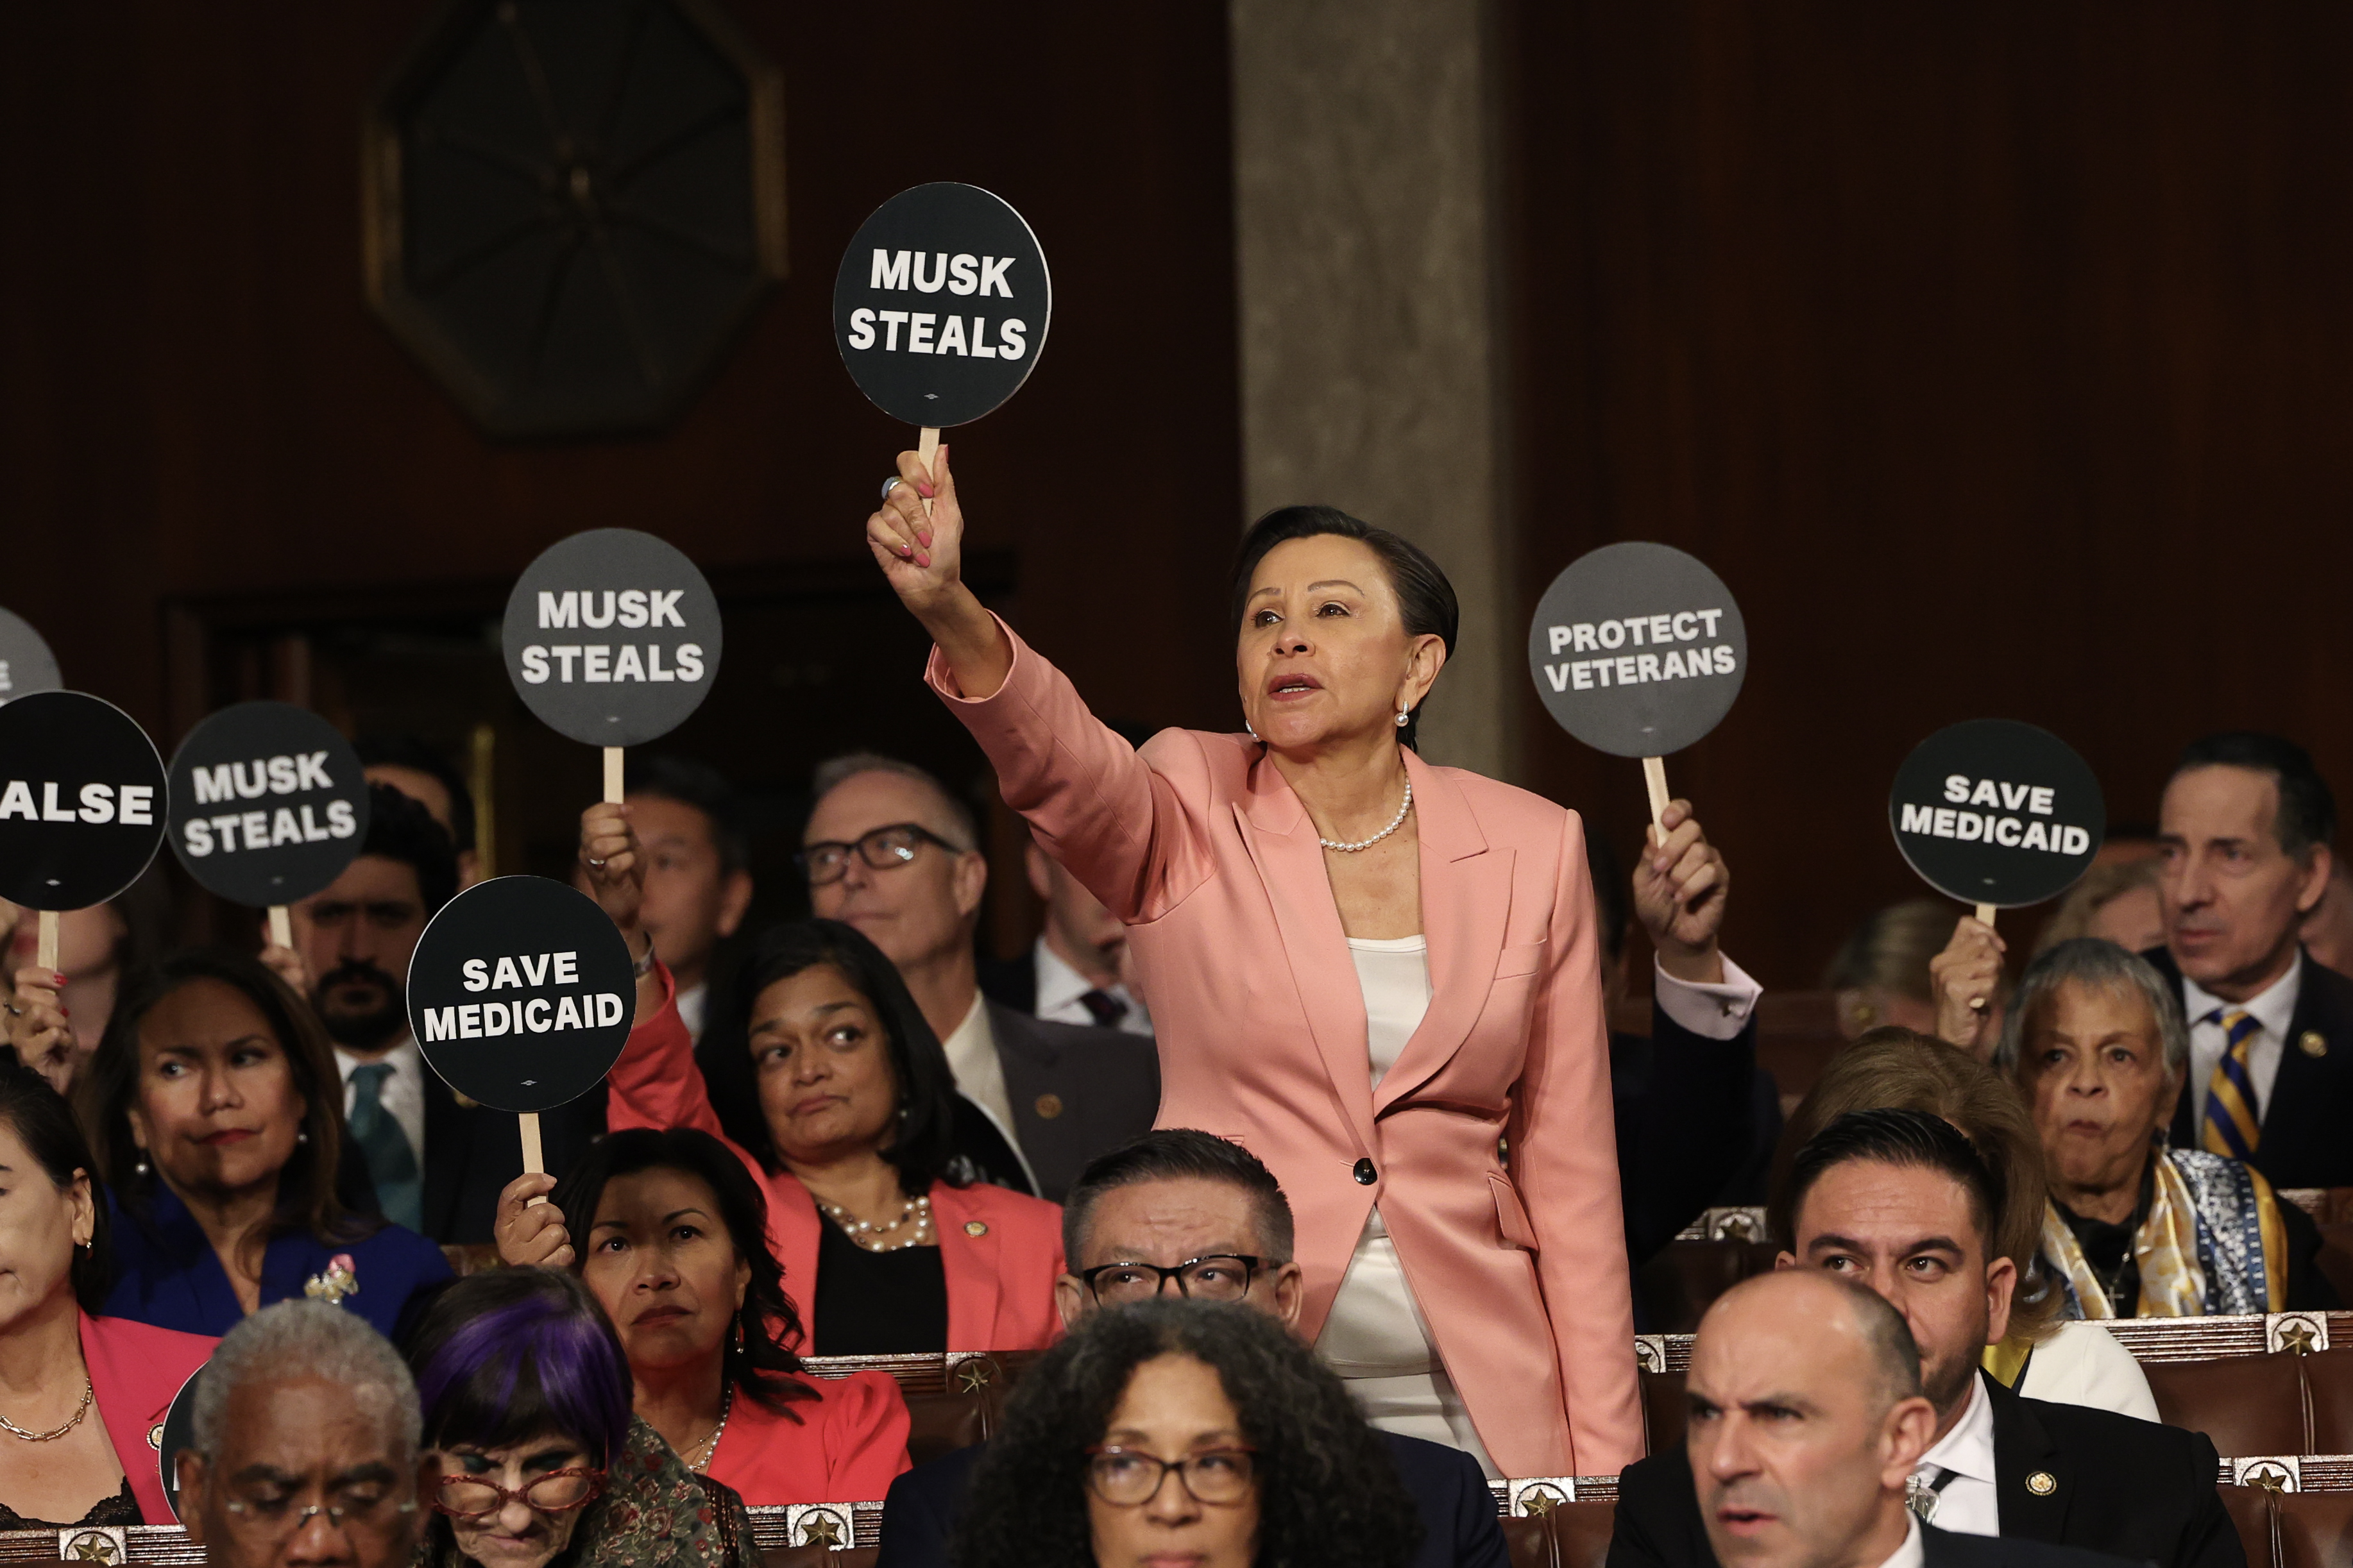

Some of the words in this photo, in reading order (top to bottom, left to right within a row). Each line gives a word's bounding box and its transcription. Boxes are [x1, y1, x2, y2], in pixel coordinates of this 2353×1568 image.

[870, 248, 1016, 298] MUSK
[848, 308, 1027, 360] STEALS
[538, 589, 686, 628] MUSK
[1549, 608, 1722, 655] PROTECT
[521, 643, 704, 684] STEALS
[1543, 645, 1736, 693] VETERANS
[192, 751, 333, 804] MUSK
[1944, 775, 2055, 815] SAVE
[184, 800, 357, 857] STEALS
[1900, 803, 2090, 855] MEDICAID
[463, 951, 579, 992] SAVE
[423, 993, 624, 1042] MEDICAID
